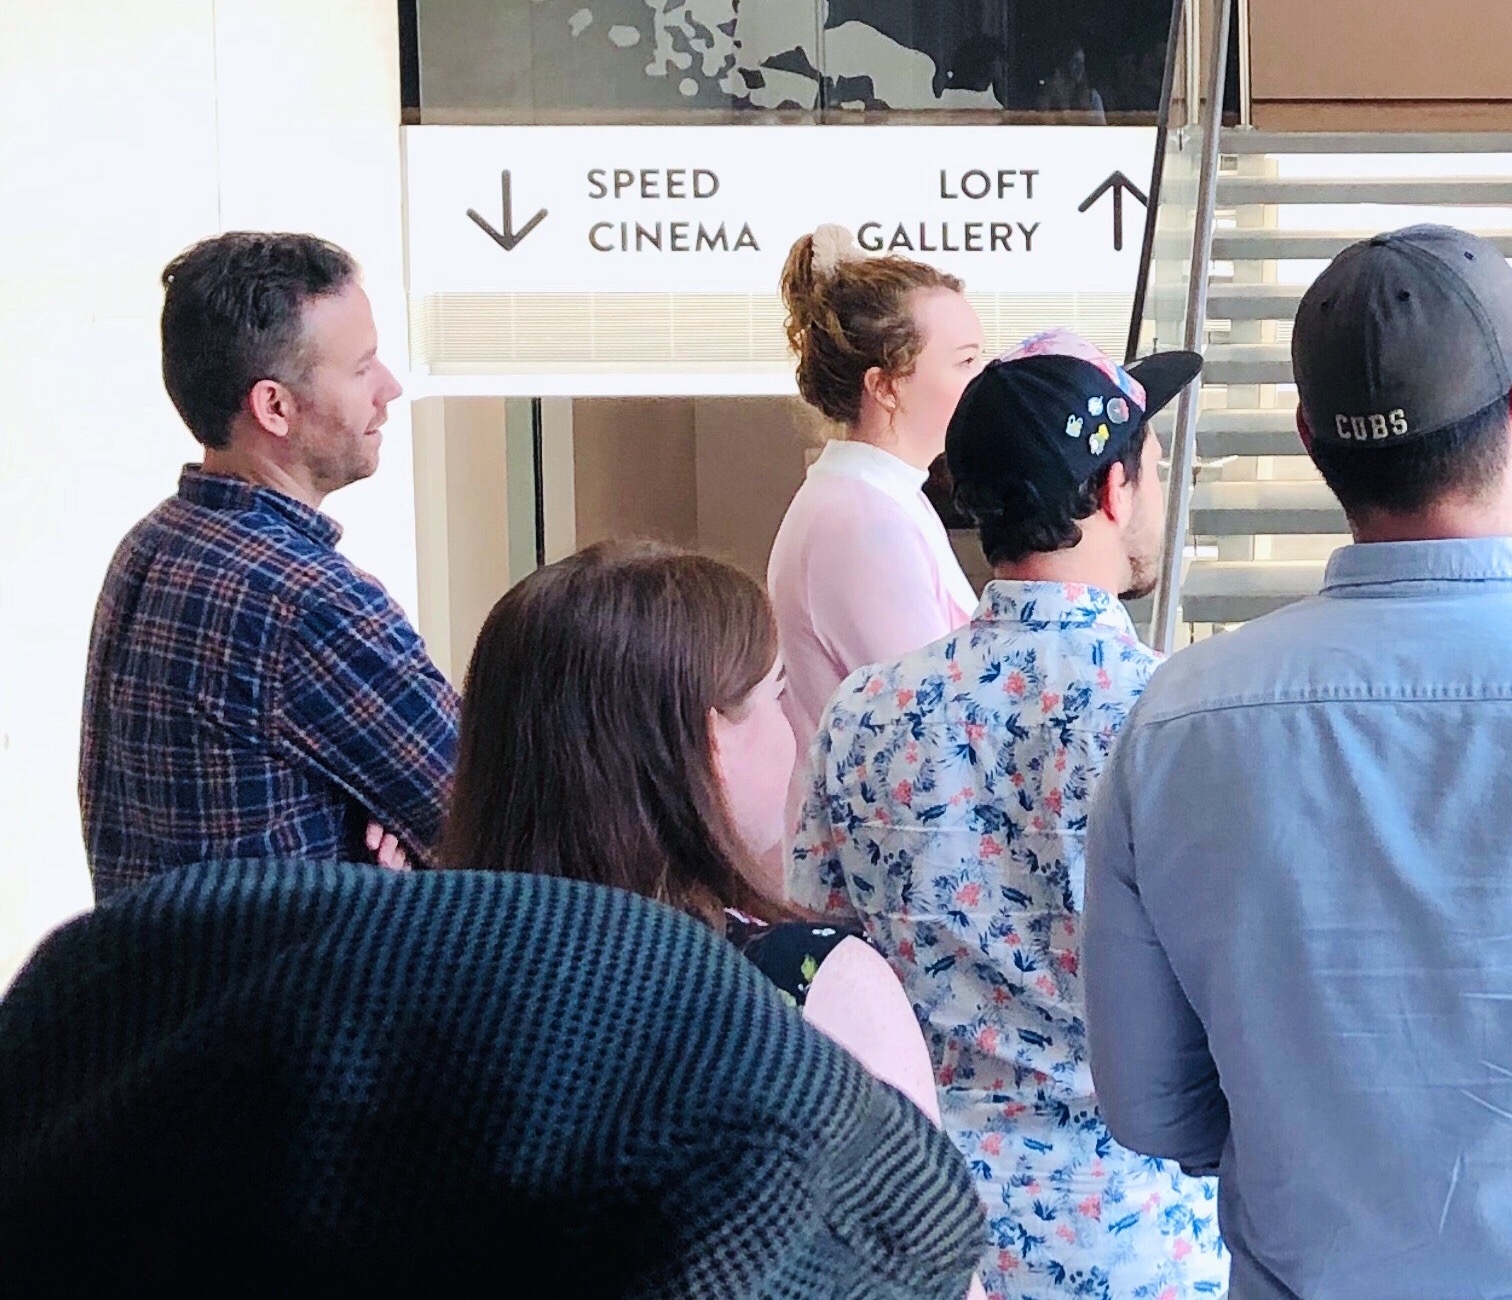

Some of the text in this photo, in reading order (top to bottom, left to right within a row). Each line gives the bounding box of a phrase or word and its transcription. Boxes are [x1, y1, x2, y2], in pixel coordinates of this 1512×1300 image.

[587, 169, 720, 200] SPEED
[940, 169, 1040, 200] LOFT
[588, 221, 761, 252] CINEMA
[857, 221, 1041, 252] GALLERY
[1335, 408, 1408, 441] CUBS
